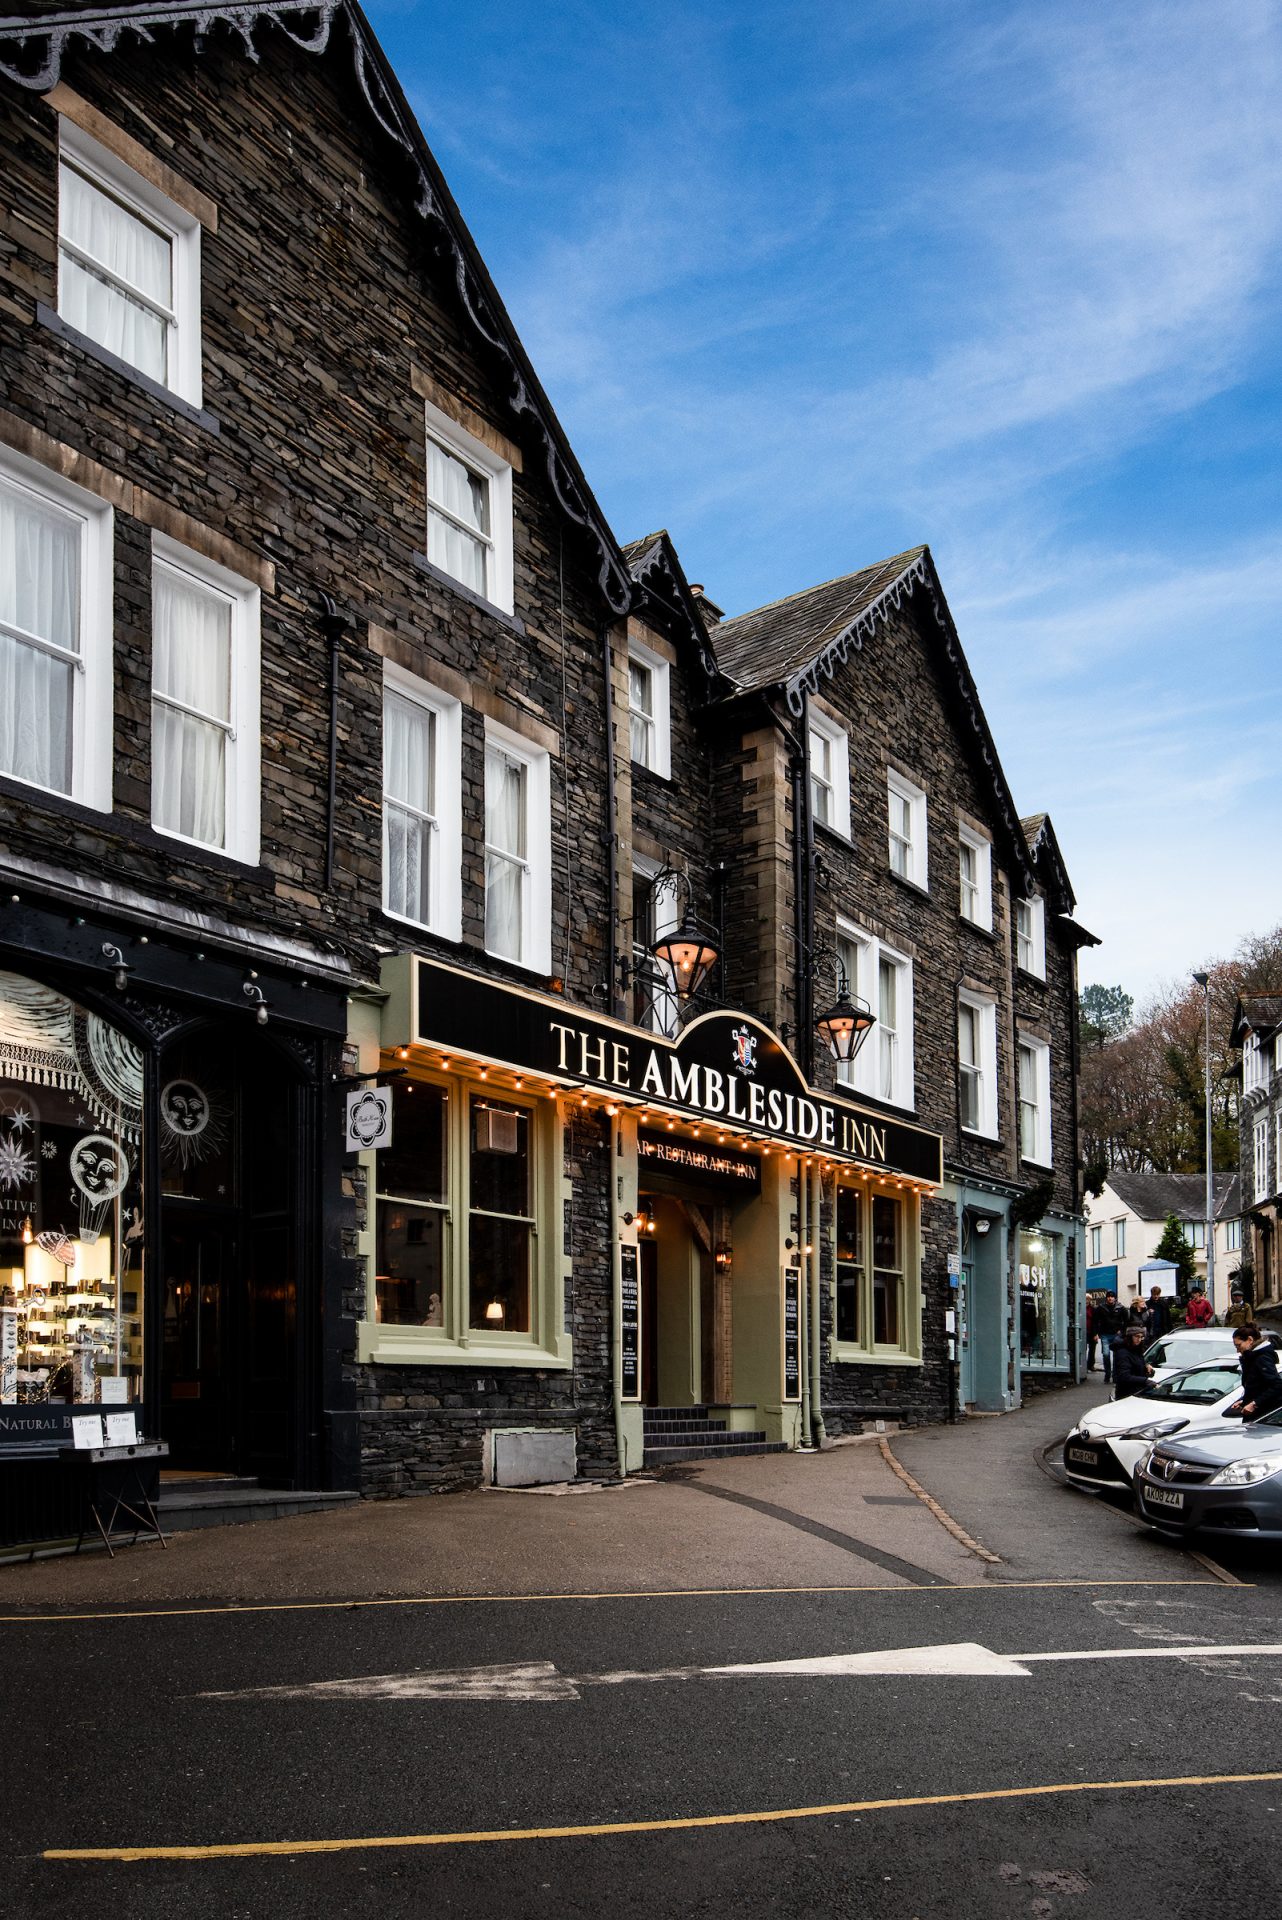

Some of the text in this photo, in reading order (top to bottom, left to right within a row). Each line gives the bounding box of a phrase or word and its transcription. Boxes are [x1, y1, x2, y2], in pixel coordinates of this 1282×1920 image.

[550, 1022, 886, 1161] THE AMBLESIDE INN
[657, 1144, 731, 1174] RESTAURANT
[736, 1163, 756, 1180] INN
[0, 1416, 58, 1430] NATURAL
[1146, 1487, 1180, 1506] AK08 ZZA
